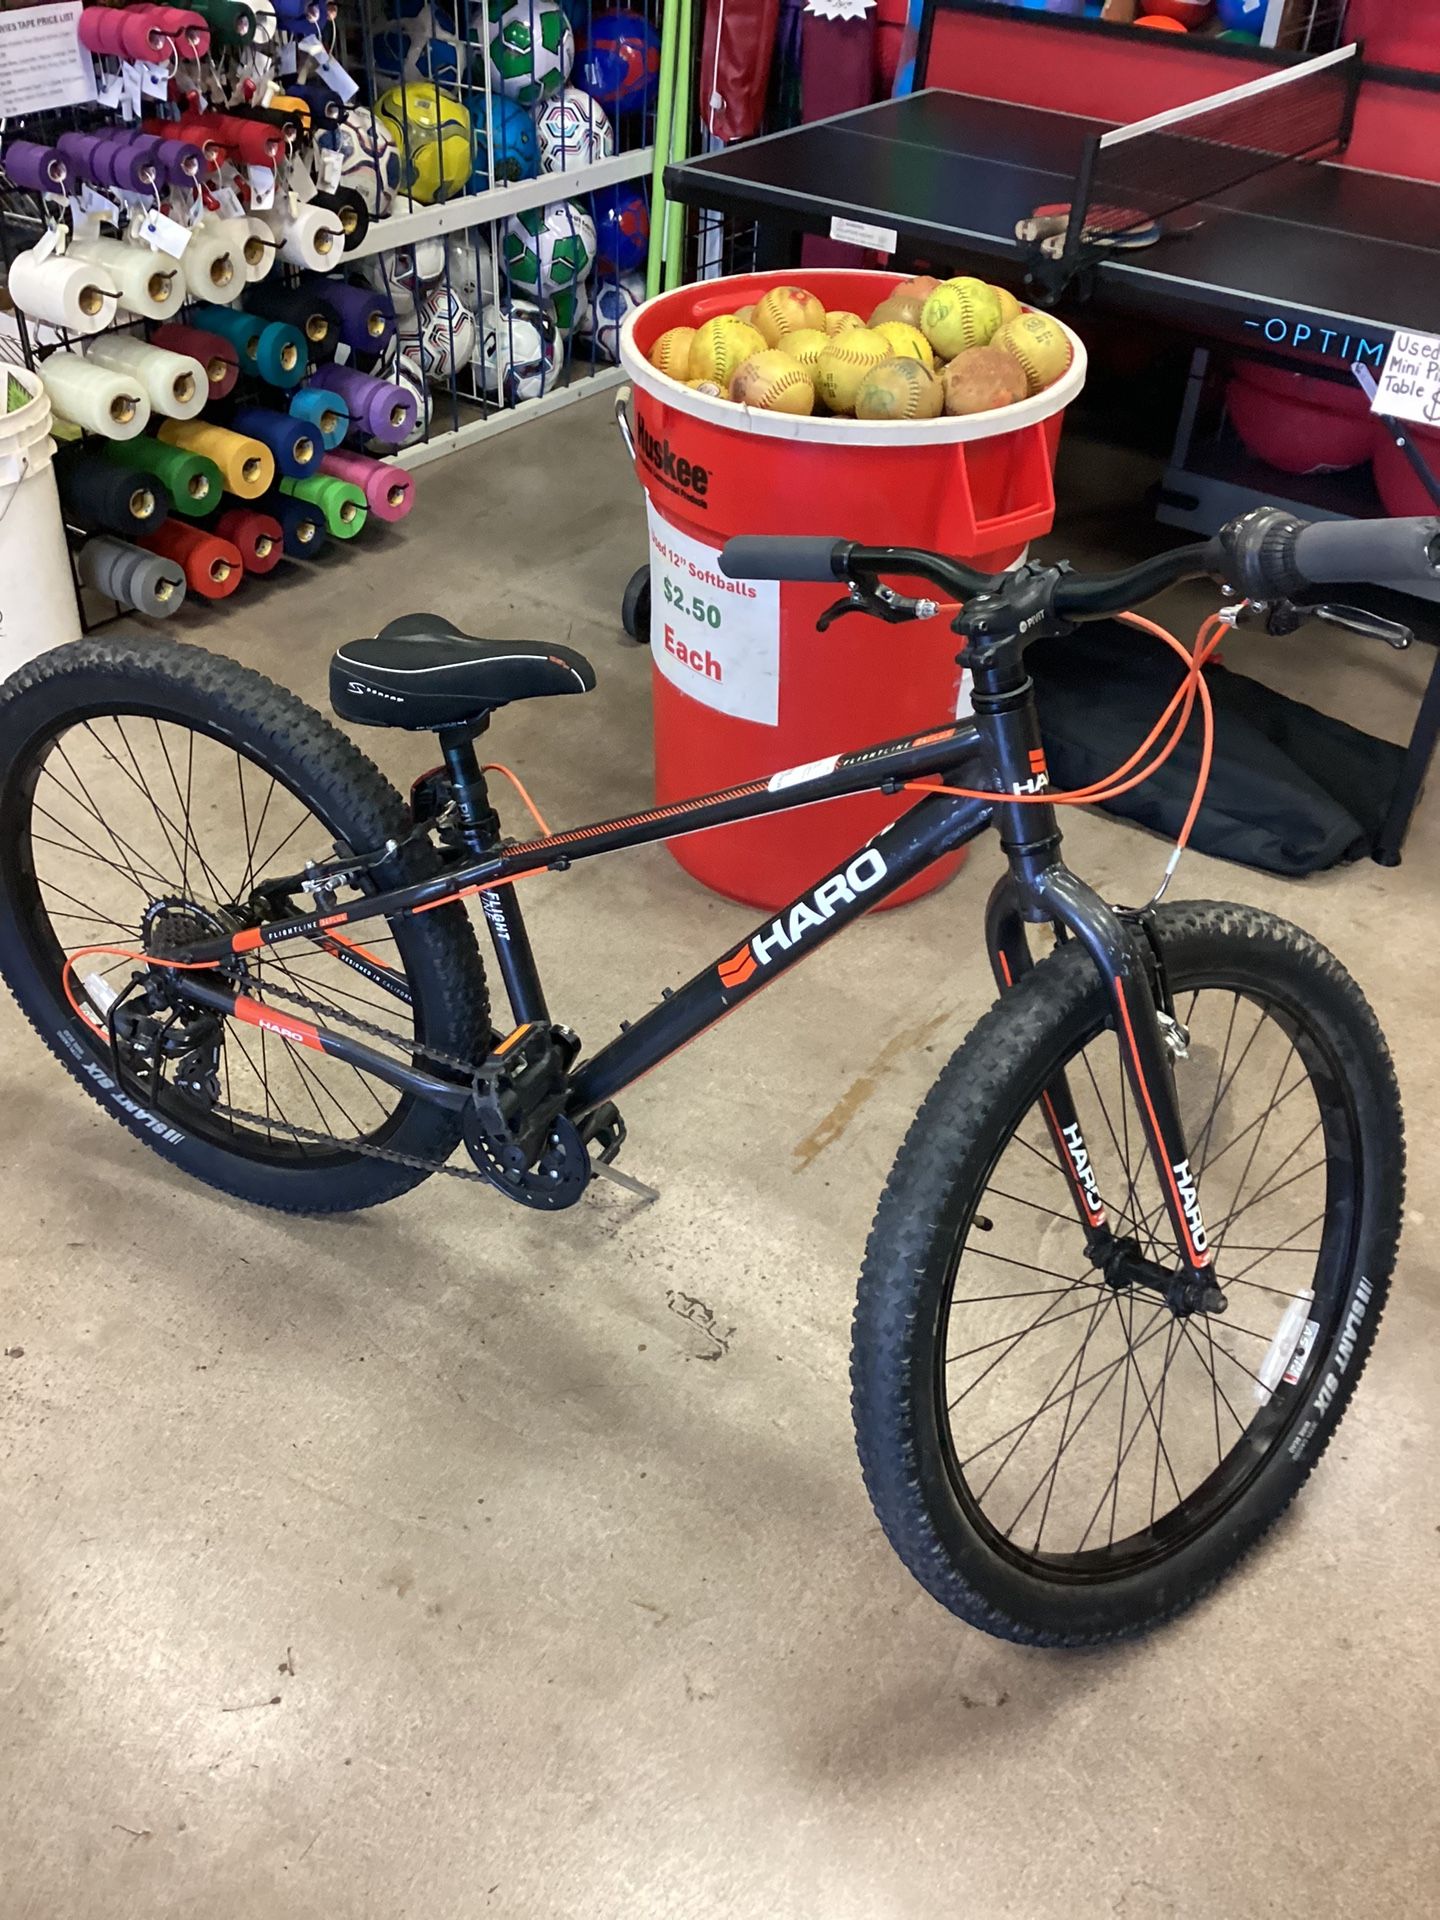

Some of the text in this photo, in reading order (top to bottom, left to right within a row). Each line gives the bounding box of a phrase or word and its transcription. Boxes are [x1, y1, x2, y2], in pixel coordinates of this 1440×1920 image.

[17, 19, 35, 29] TAPE
[37, 15, 58, 25] PRICE
[60, 12, 74, 21] LIST
[1384, 375, 1425, 397] Table
[1389, 356, 1422, 375] Mini
[638, 412, 708, 495] Huskee
[688, 562, 757, 598] Softballs
[664, 576, 721, 629] $2.50
[664, 623, 722, 682] Each
[843, 742, 910, 766] FLIGHTLINE
[487, 892, 511, 941] FLIGHT
[751, 848, 888, 965] HARO
[268, 922, 318, 940] FLIGHTLINE
[341, 954, 372, 976] DESIGNED
[258, 1019, 304, 1042] HARO
[111, 1093, 169, 1135] SLANT
[1062, 1122, 1102, 1211] HARO
[1173, 1159, 1208, 1252] HARO
[1313, 1299, 1366, 1418] SLANT SIX
